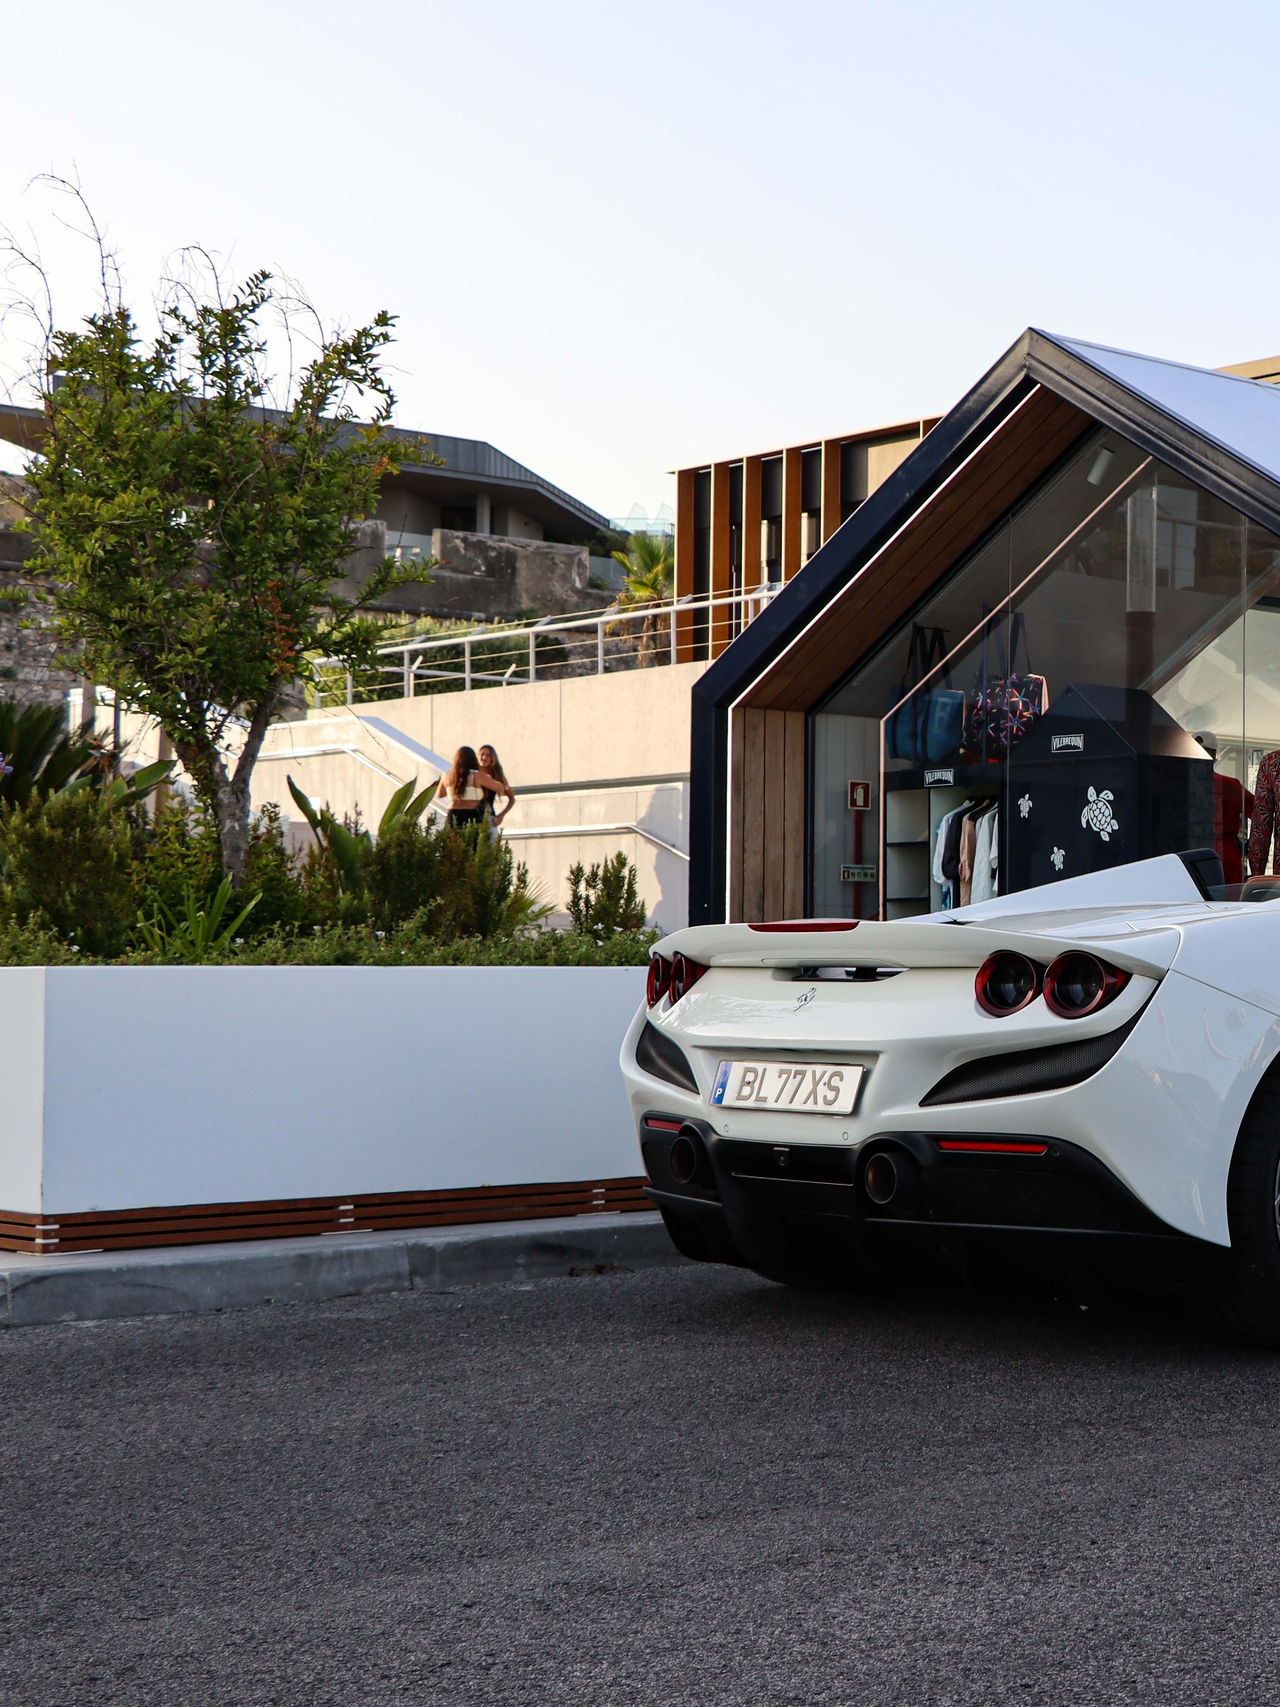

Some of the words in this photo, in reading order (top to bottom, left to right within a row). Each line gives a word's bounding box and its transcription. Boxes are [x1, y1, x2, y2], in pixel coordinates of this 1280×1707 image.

[1052, 736, 1083, 751] VILEBREQUIN
[925, 771, 953, 785] VILEBREQUIN
[715, 1088, 723, 1098] P
